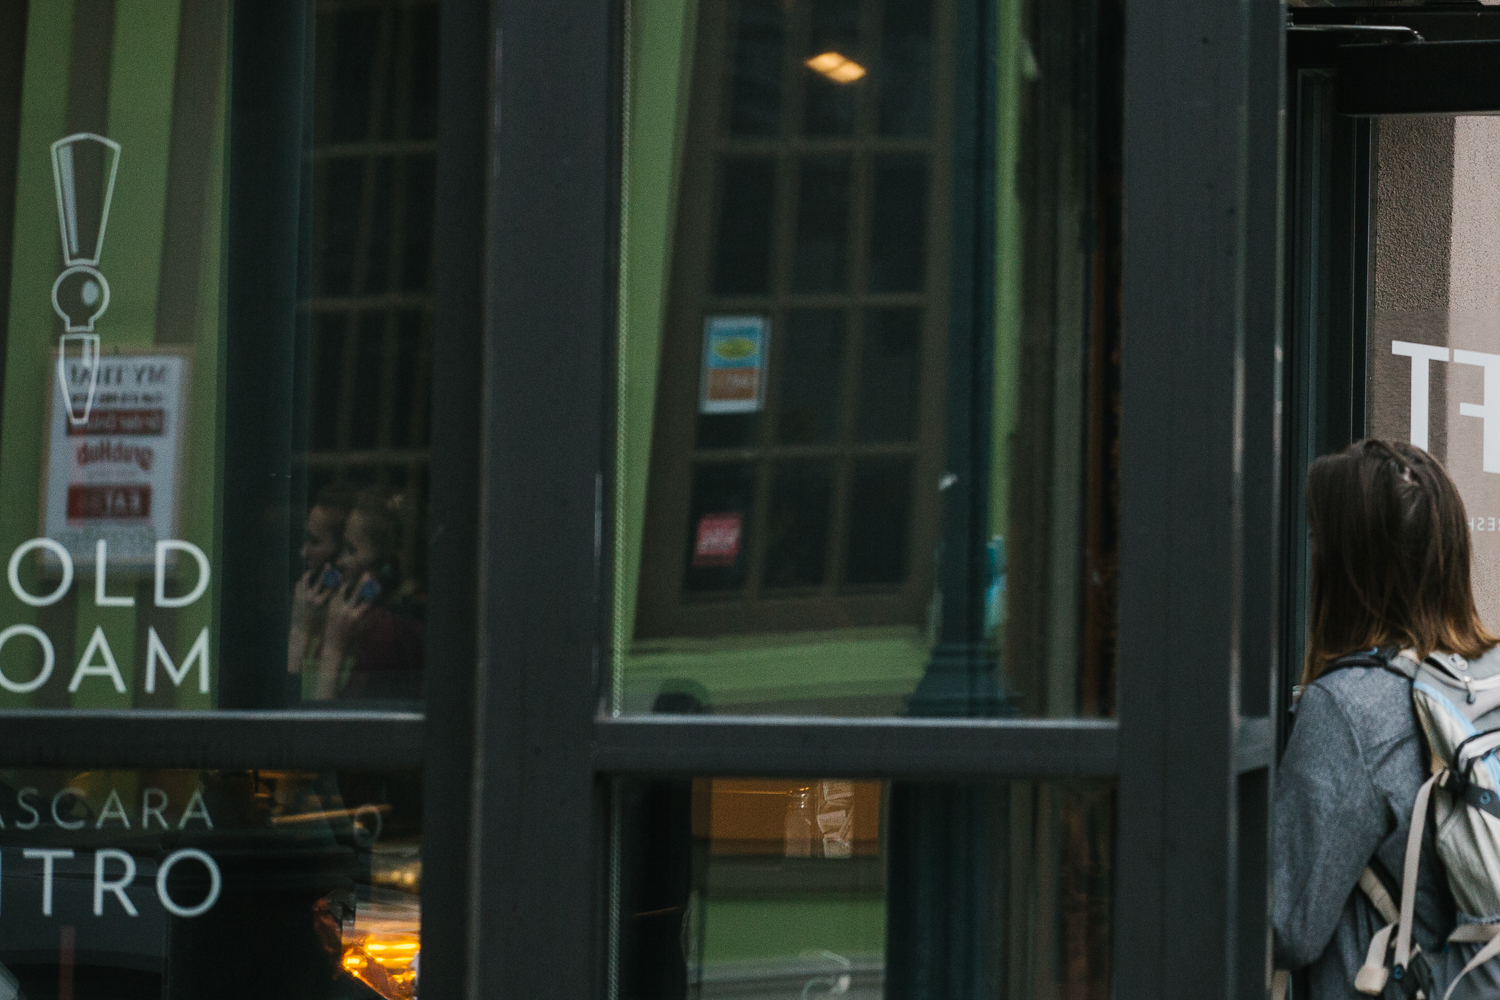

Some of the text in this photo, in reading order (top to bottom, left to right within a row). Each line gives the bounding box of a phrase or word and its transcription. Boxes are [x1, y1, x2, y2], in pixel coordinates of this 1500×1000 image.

[7, 537, 211, 608] OLD
[0, 623, 210, 694] OAM
[0, 787, 214, 831] SCARA
[0, 848, 222, 918] TRO
